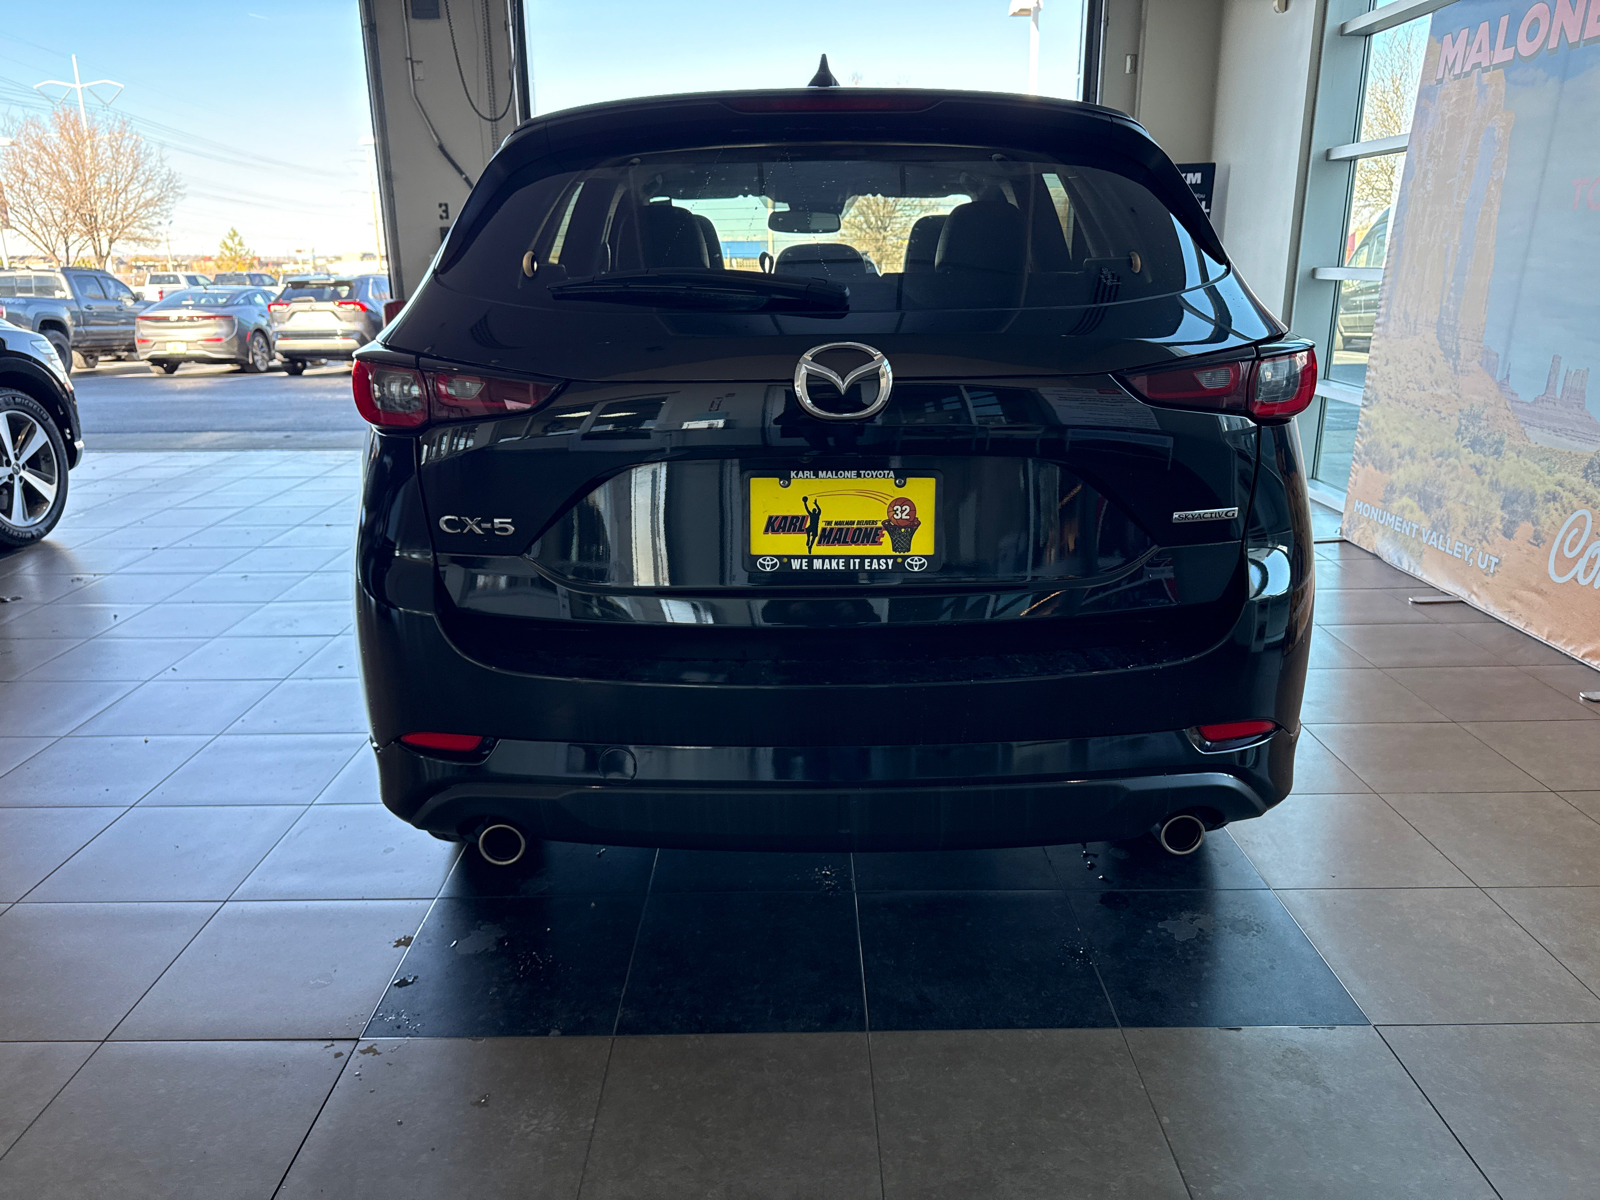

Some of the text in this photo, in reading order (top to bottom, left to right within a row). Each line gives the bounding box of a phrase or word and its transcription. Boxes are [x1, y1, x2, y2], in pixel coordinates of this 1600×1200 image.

[438, 203, 449, 220] 3
[14, 397, 50, 420] MICHELIN
[790, 470, 895, 479] KARL MALONE TOYOTA
[893, 505, 911, 519] 32
[439, 515, 515, 536] CX-5
[763, 515, 808, 534] KARL
[817, 526, 884, 546] MALONE
[1354, 498, 1499, 574] MONUMENT VALLEY, UT
[791, 559, 893, 570] WE MAKE IT EASY
